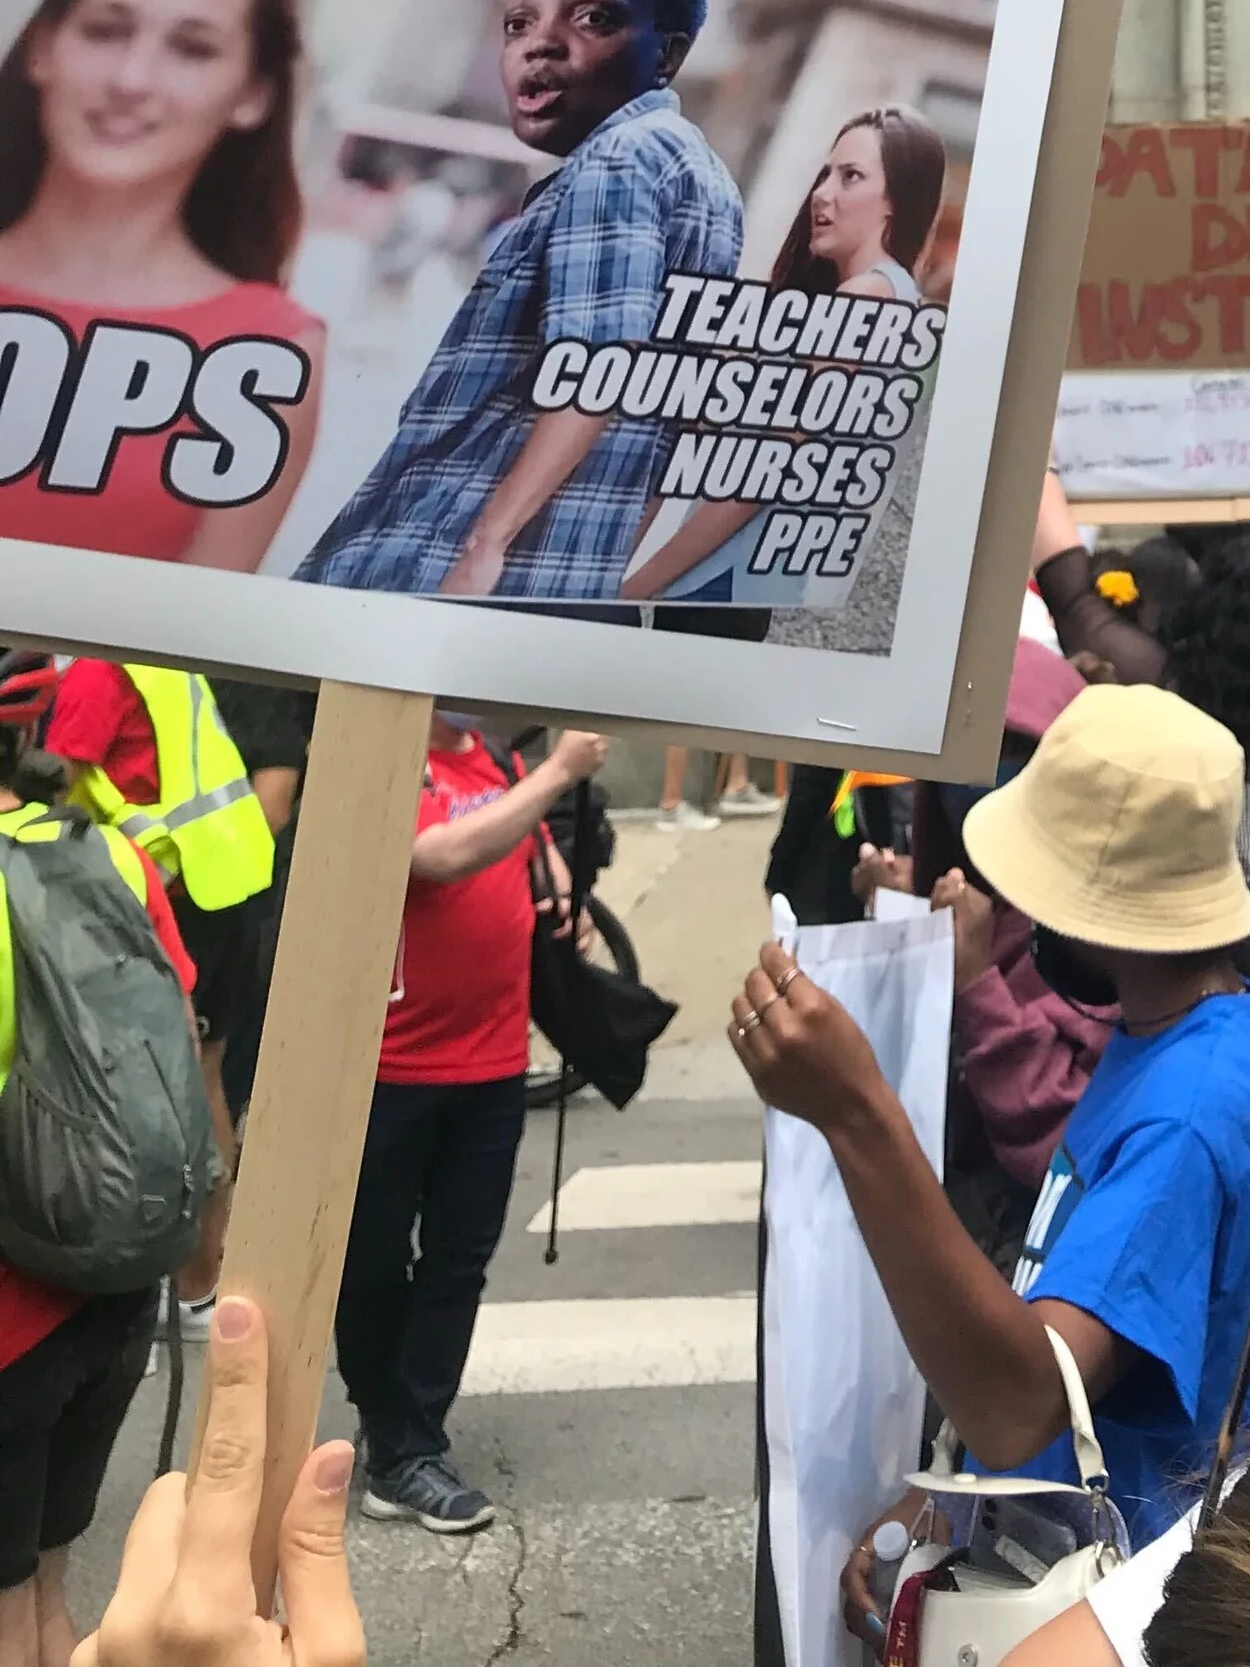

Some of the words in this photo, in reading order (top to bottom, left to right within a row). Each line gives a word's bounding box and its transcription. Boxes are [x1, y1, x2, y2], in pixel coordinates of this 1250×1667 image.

[655, 271, 947, 371] TEACHERS
[530, 338, 924, 440] COUNSELORS
[657, 430, 896, 510] NURSES
[747, 510, 871, 577] PPE
